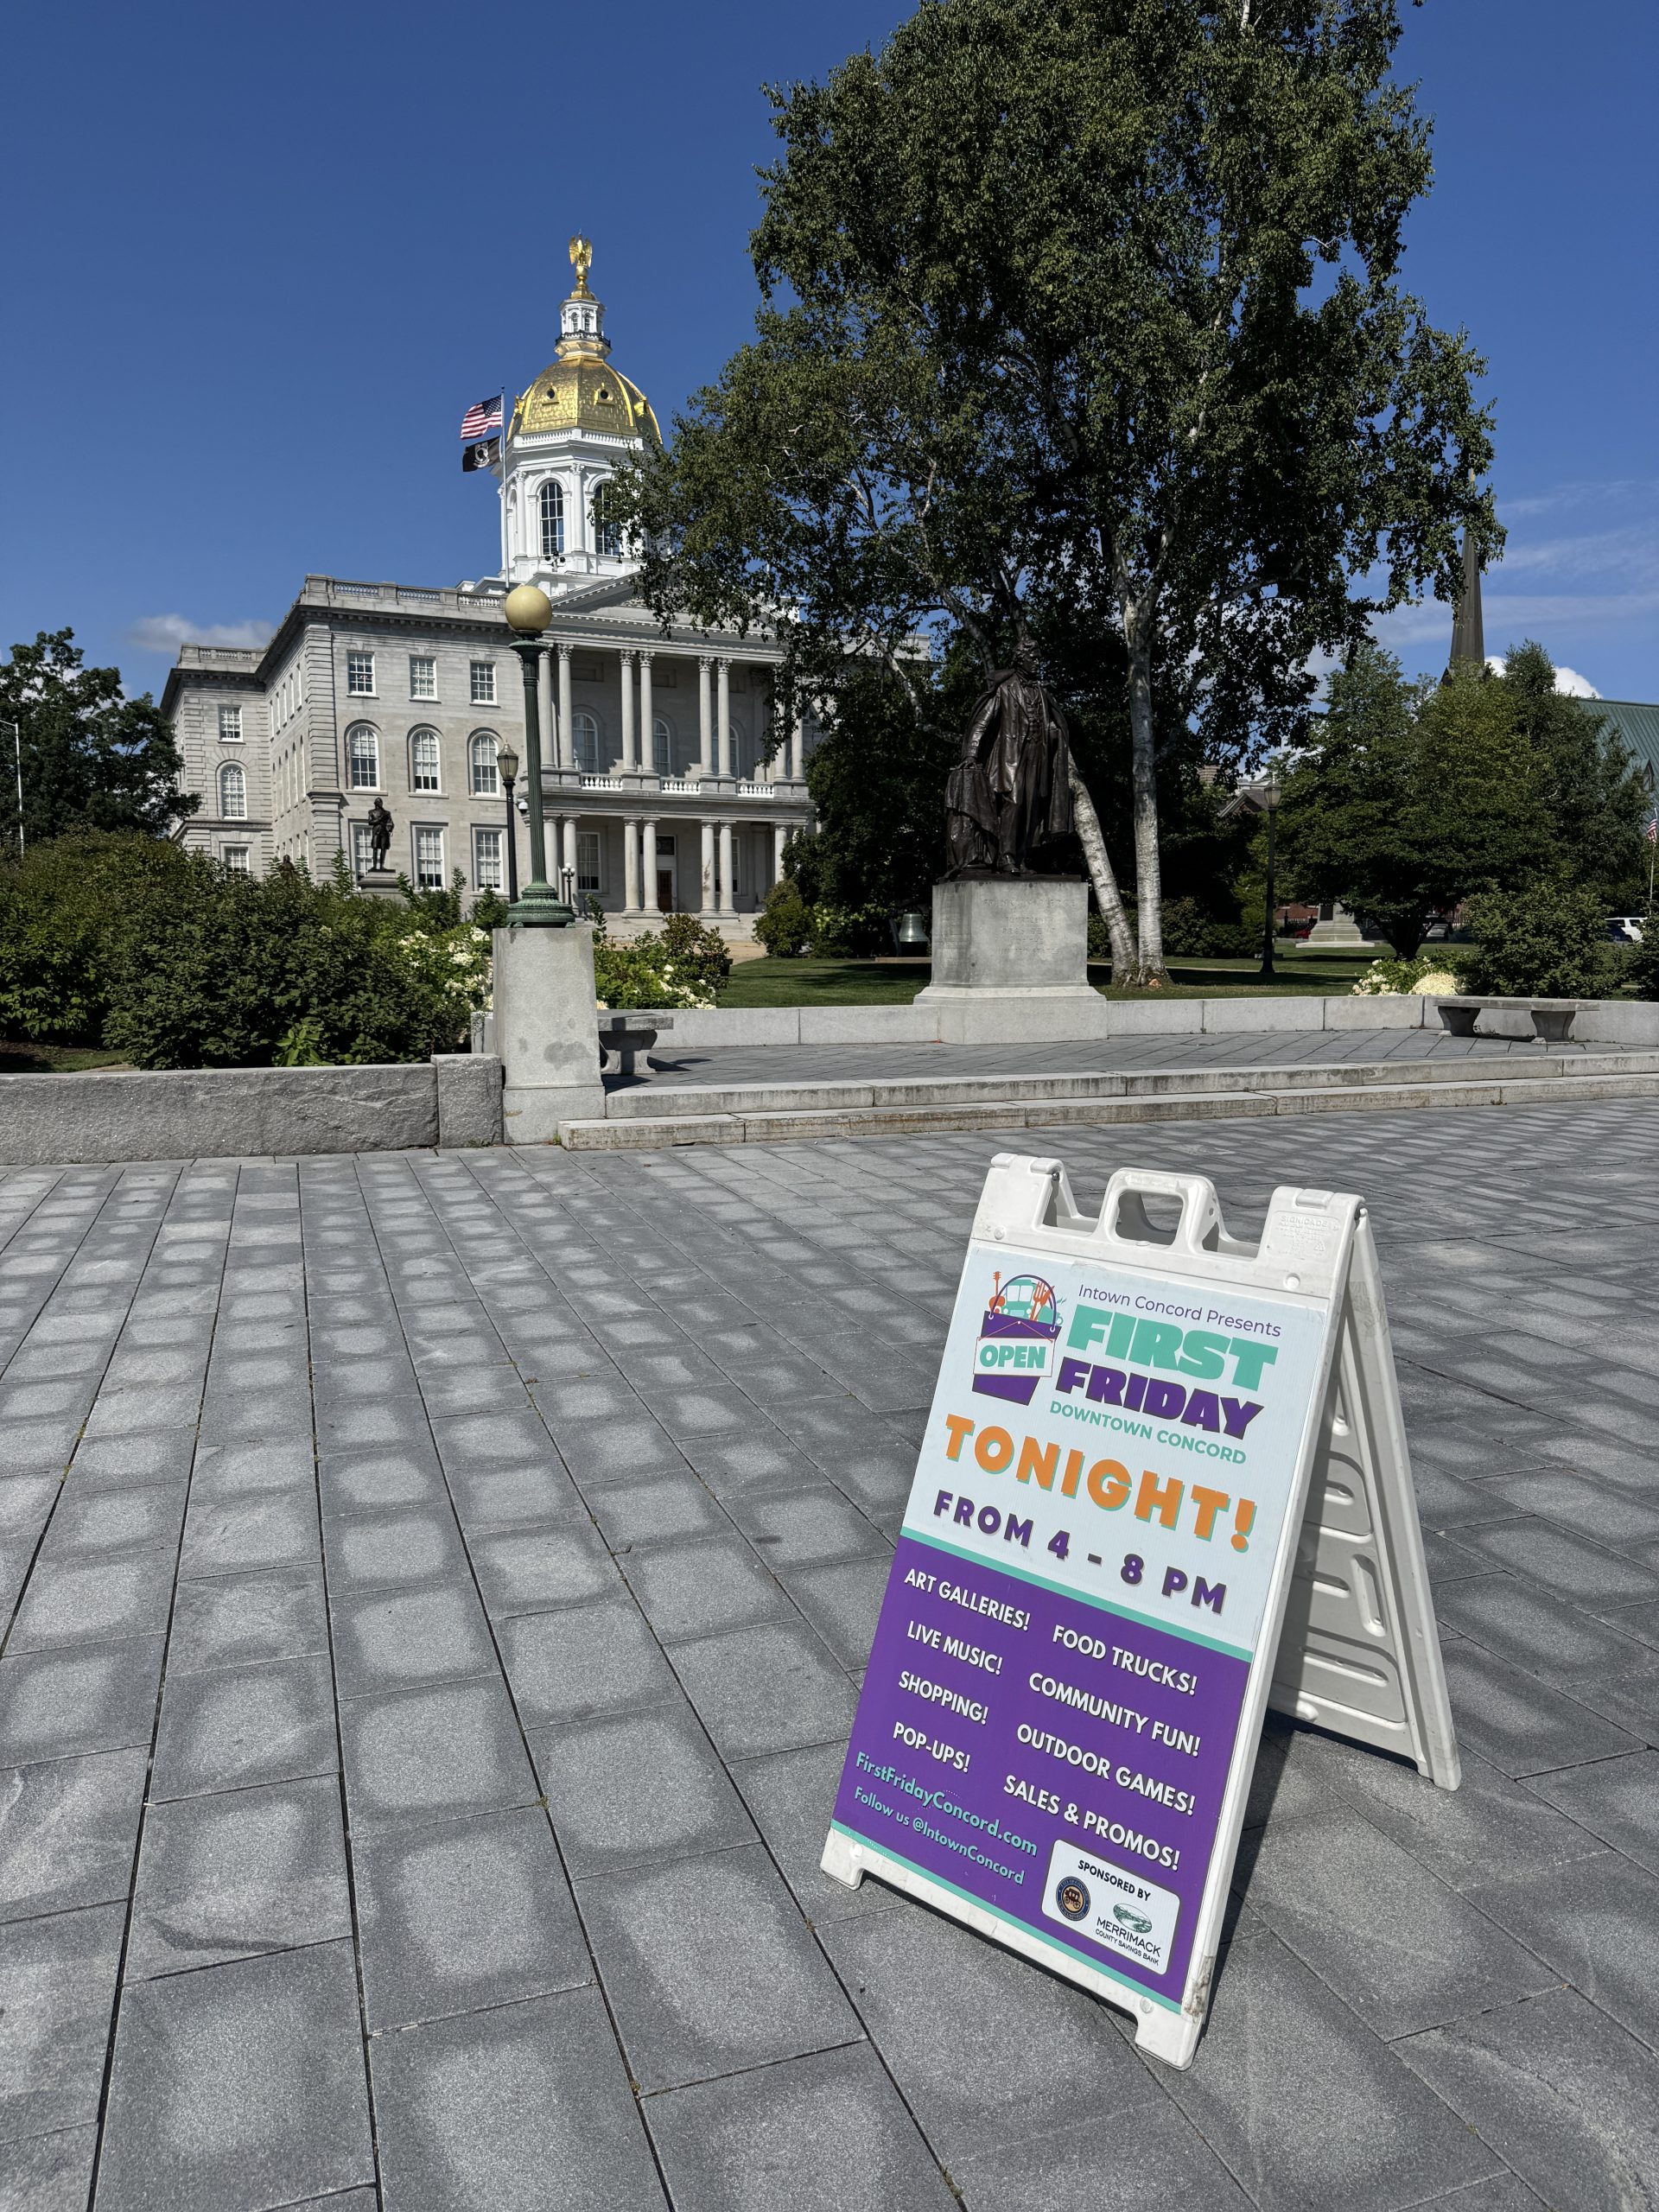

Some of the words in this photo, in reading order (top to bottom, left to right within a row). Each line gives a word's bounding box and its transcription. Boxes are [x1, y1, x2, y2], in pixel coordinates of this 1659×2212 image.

[1281, 1215, 1328, 1228] SIGNICADE
[1078, 1284, 1130, 1306] Intown
[1135, 1296, 1201, 1321] Concord
[1206, 1310, 1281, 1338] Presents
[979, 1344, 1046, 1370] OPEN
[1066, 1304, 1279, 1392] FIRST
[1055, 1357, 1265, 1440] FRIDAY
[1049, 1400, 1154, 1440] DOWNTOWN
[1157, 1430, 1247, 1465] CONCORD
[945, 1414, 1258, 1553] TONIGHT!
[933, 1490, 1035, 1548] FROM
[1047, 1529, 1071, 1560] 4
[1087, 1553, 1103, 1566] -
[1120, 1553, 1145, 1586] 8
[1161, 1566, 1228, 1616] PM
[904, 1568, 938, 1594] ART
[938, 1581, 1032, 1632] GALLERIES!
[907, 1620, 941, 1650] LIVE
[943, 1636, 1004, 1676] MUSIC!
[1052, 1624, 1107, 1661] FOOD
[1111, 1646, 1198, 1697] TRUCKS!
[899, 1670, 989, 1726] SHOPPING!
[1028, 1672, 1150, 1735] COMMUNITY
[1151, 1719, 1201, 1758] FUN!
[893, 1721, 971, 1774] POP-UPS!
[1017, 1723, 1111, 1780] OUTDOOR
[1116, 1766, 1197, 1816] GAMES!
[854, 1786, 894, 1817] Follow
[895, 1811, 910, 1827] us
[912, 1818, 1026, 1885] @IntownConcord
[855, 1751, 1038, 1857] FirstFridayConcord.com
[1003, 1774, 1060, 1816] SALES
[1064, 1802, 1080, 1826] &
[1083, 1810, 1182, 1872] PROMOS!
[1077, 1859, 1135, 1895] SPONSORED
[1137, 1890, 1152, 1902] BY
[1095, 1928, 1119, 1945] COUNTY
[1118, 1939, 1143, 1958] SAVINGS
[1142, 1952, 1160, 1967] BANK
[1096, 1916, 1161, 1958] MERRIMACK
